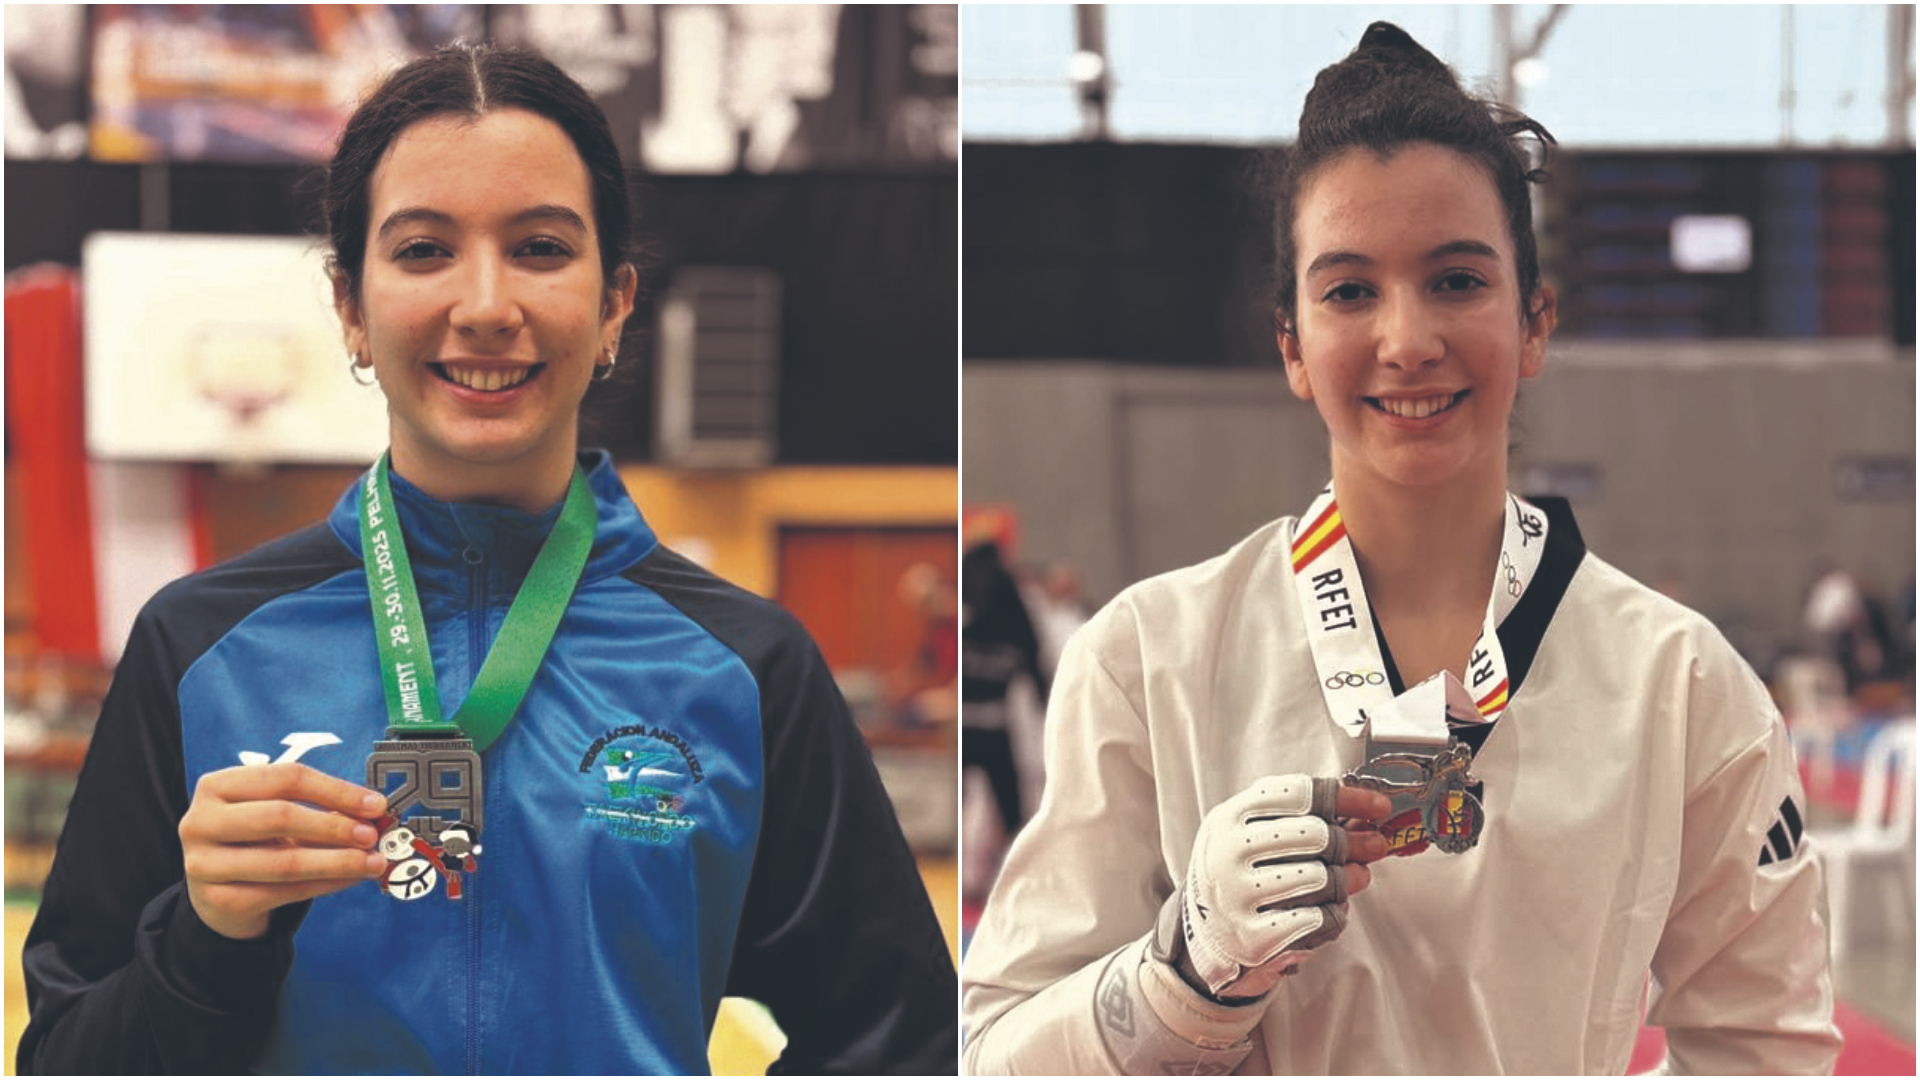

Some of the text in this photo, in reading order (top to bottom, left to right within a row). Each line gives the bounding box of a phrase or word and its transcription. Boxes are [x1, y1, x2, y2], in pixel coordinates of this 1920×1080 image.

[1311, 568, 1358, 632] RFET
[366, 752, 483, 832] 29
[1390, 825, 1428, 846] FET
